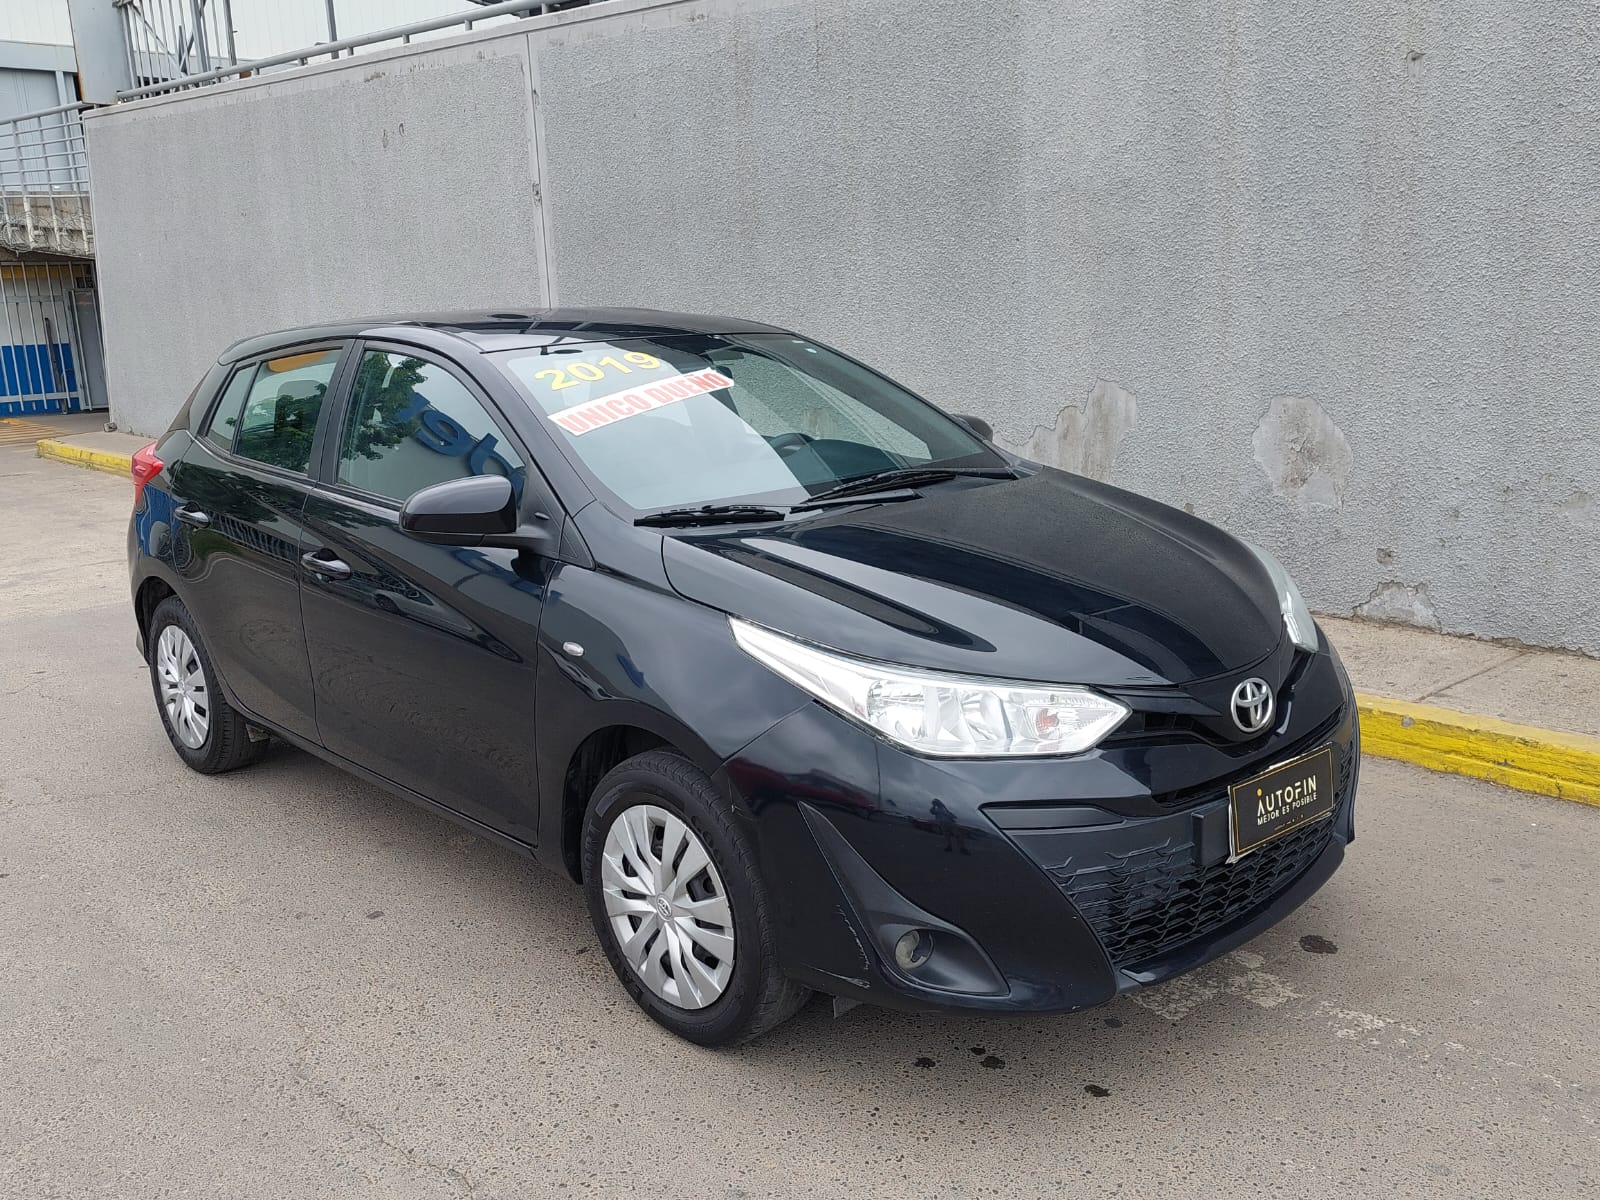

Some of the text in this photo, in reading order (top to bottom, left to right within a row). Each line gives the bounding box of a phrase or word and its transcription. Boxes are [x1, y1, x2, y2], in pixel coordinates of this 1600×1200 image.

[534, 351, 661, 391] 2019
[557, 372, 731, 433] UNICO DUEÑO
[1257, 775, 1317, 817] AUTOFIN
[1257, 811, 1280, 826] MEJOR
[1282, 806, 1290, 815] ES
[1292, 792, 1317, 810] POSIBLE
